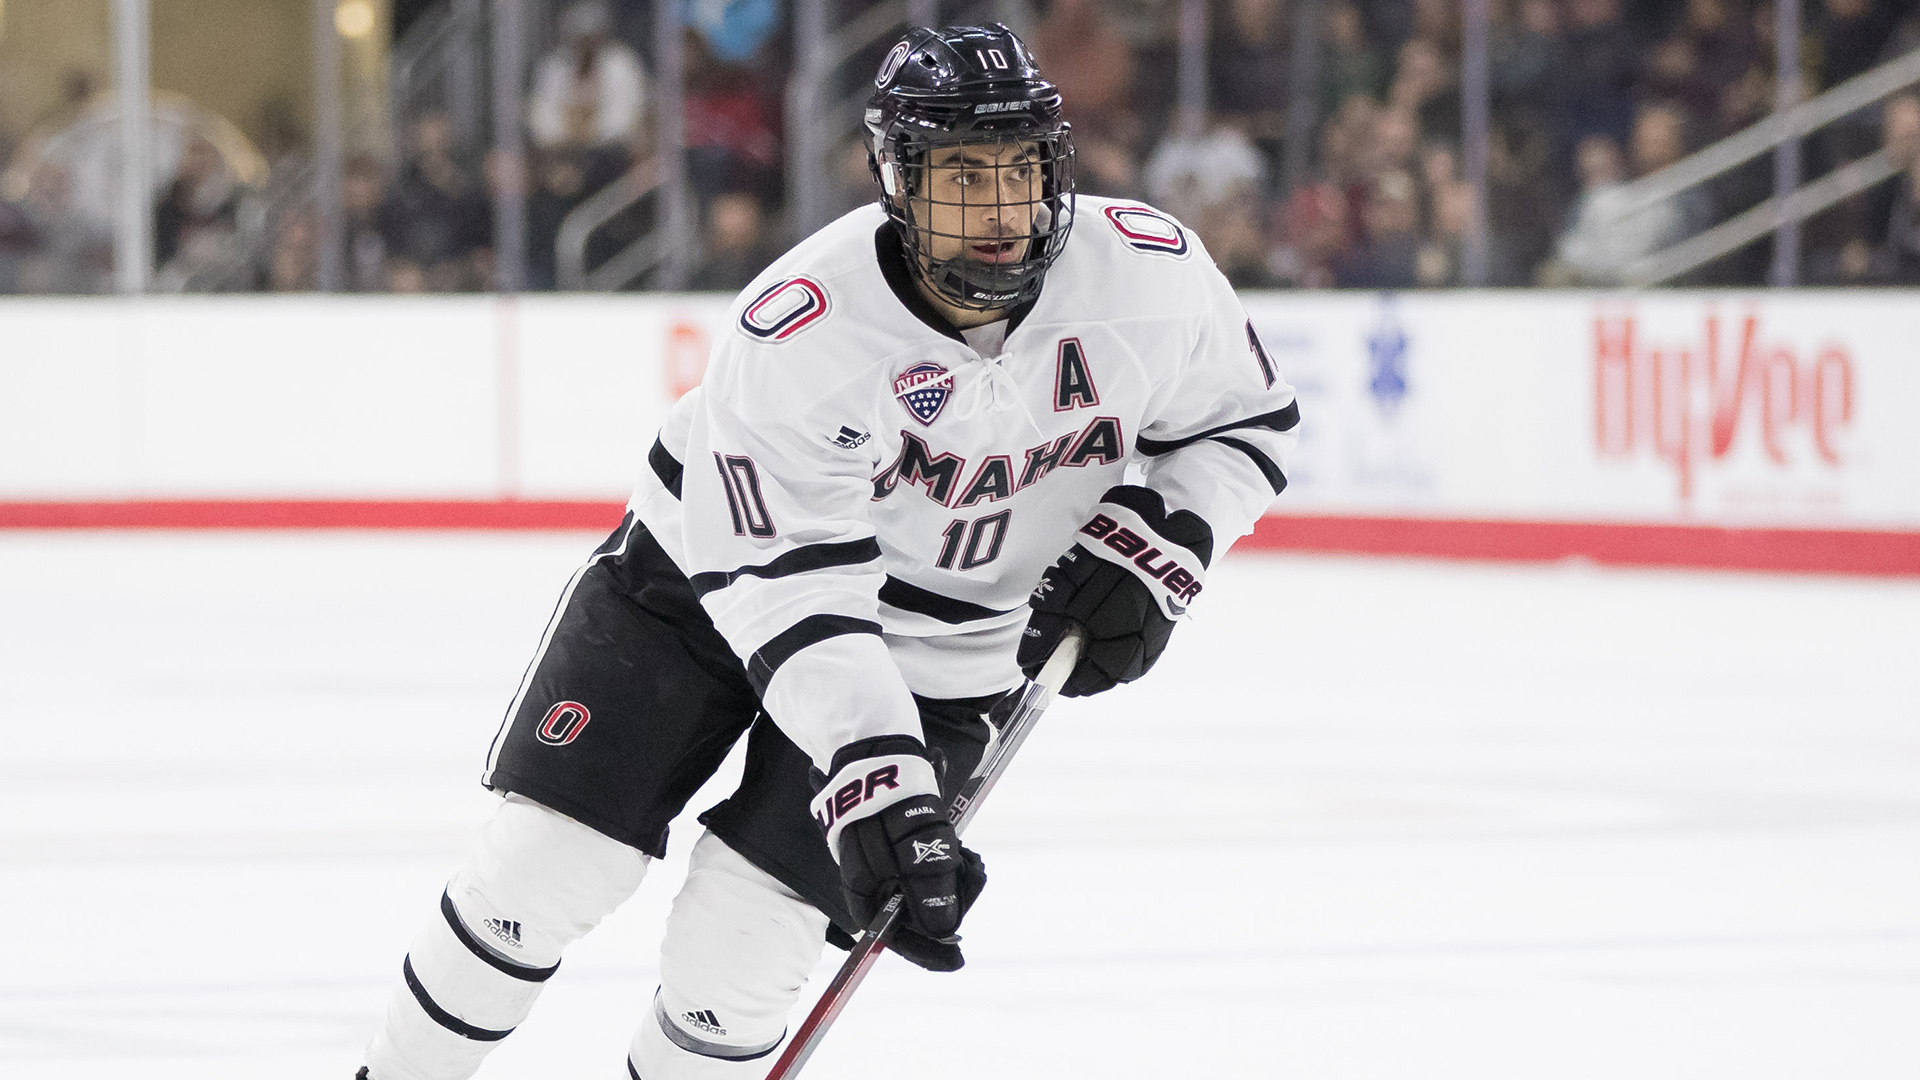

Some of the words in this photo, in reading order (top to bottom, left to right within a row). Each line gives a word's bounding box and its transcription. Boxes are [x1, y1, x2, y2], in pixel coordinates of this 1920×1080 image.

[976, 49, 1009, 70] 10
[974, 101, 1031, 115] BAUER
[1054, 337, 1100, 412] A
[1245, 318, 1279, 390] 1
[712, 451, 776, 538] 10
[935, 509, 1012, 571] 10
[1079, 513, 1202, 606] BAUER
[905, 806, 935, 818] OMAHA
[483, 918, 523, 949] adidas
[681, 1013, 727, 1036] adidas
